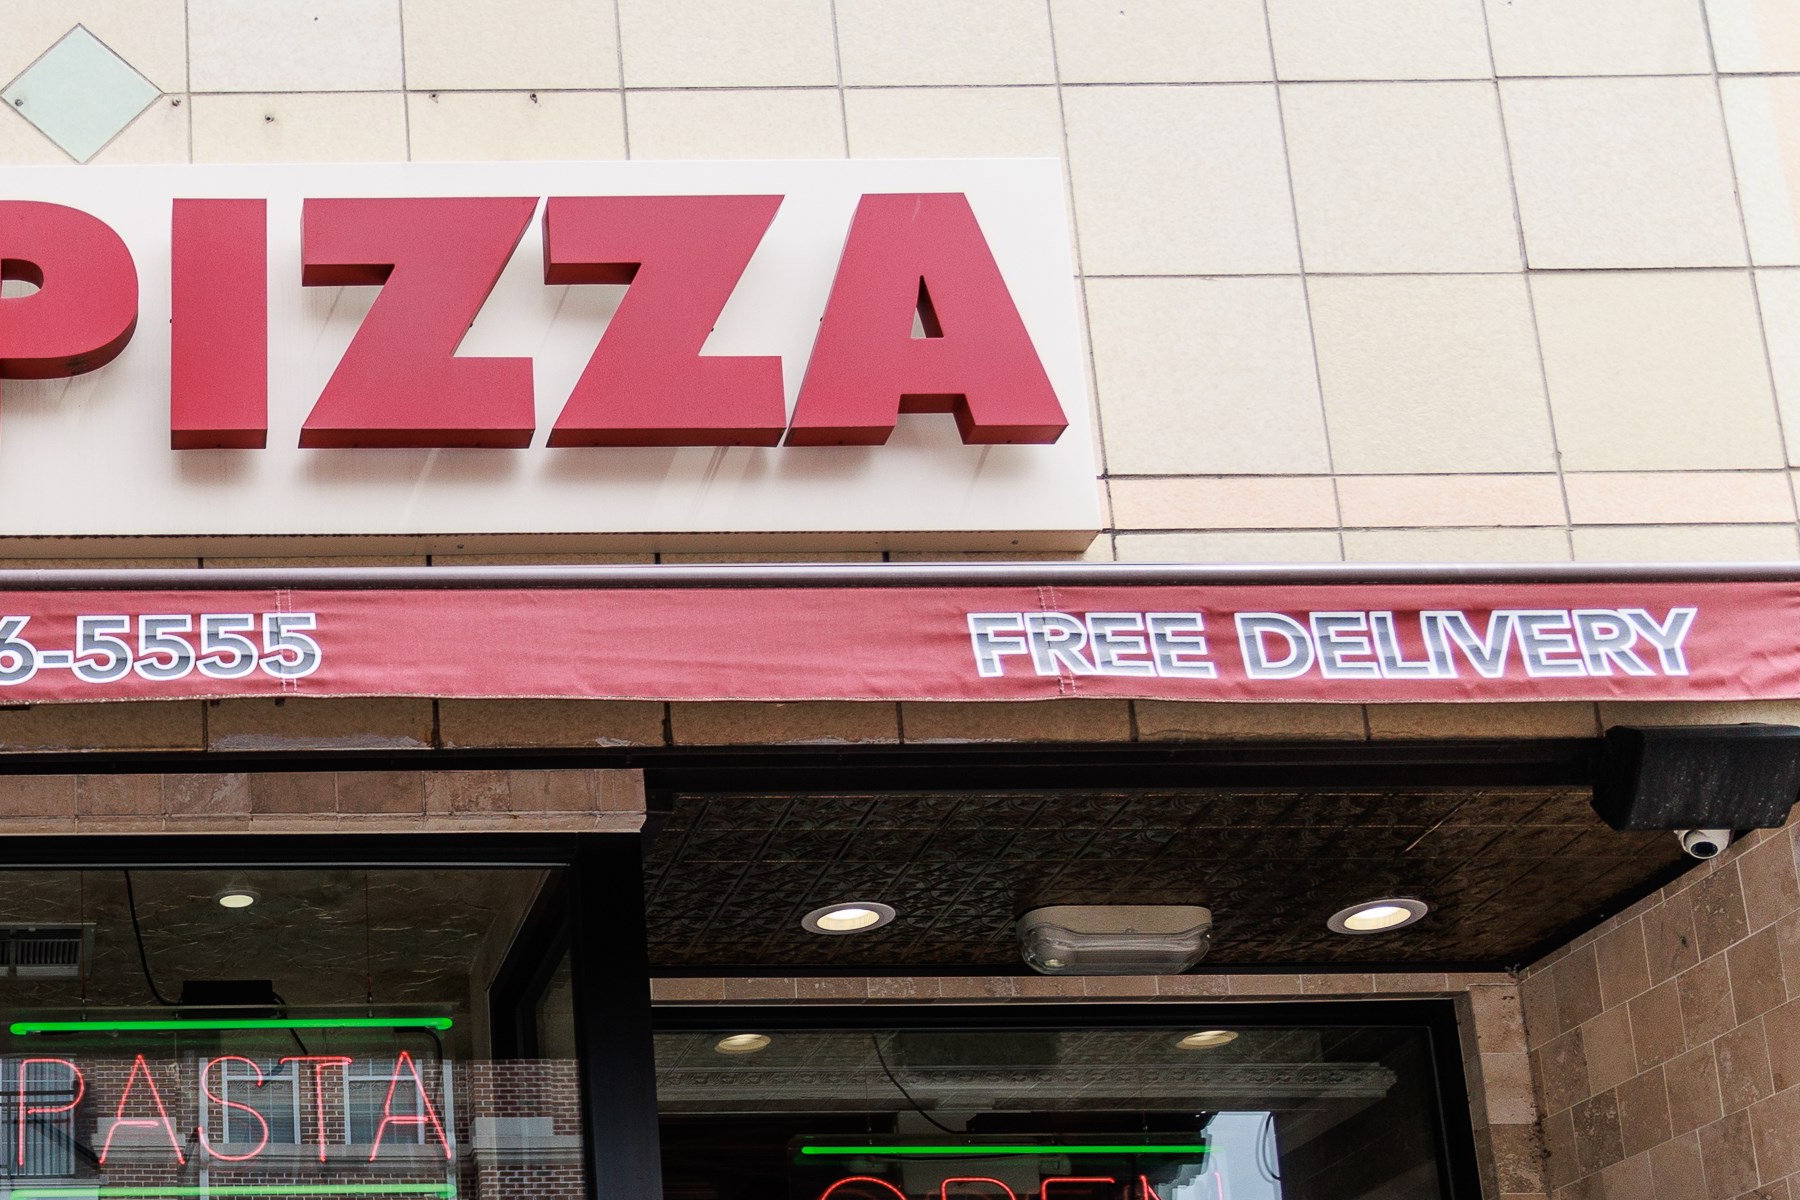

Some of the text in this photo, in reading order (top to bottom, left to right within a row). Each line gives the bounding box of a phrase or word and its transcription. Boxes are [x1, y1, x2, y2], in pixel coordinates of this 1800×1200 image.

[967, 607, 1698, 681] FREE DELIVERY
[17, 1050, 452, 1166] PASTA
